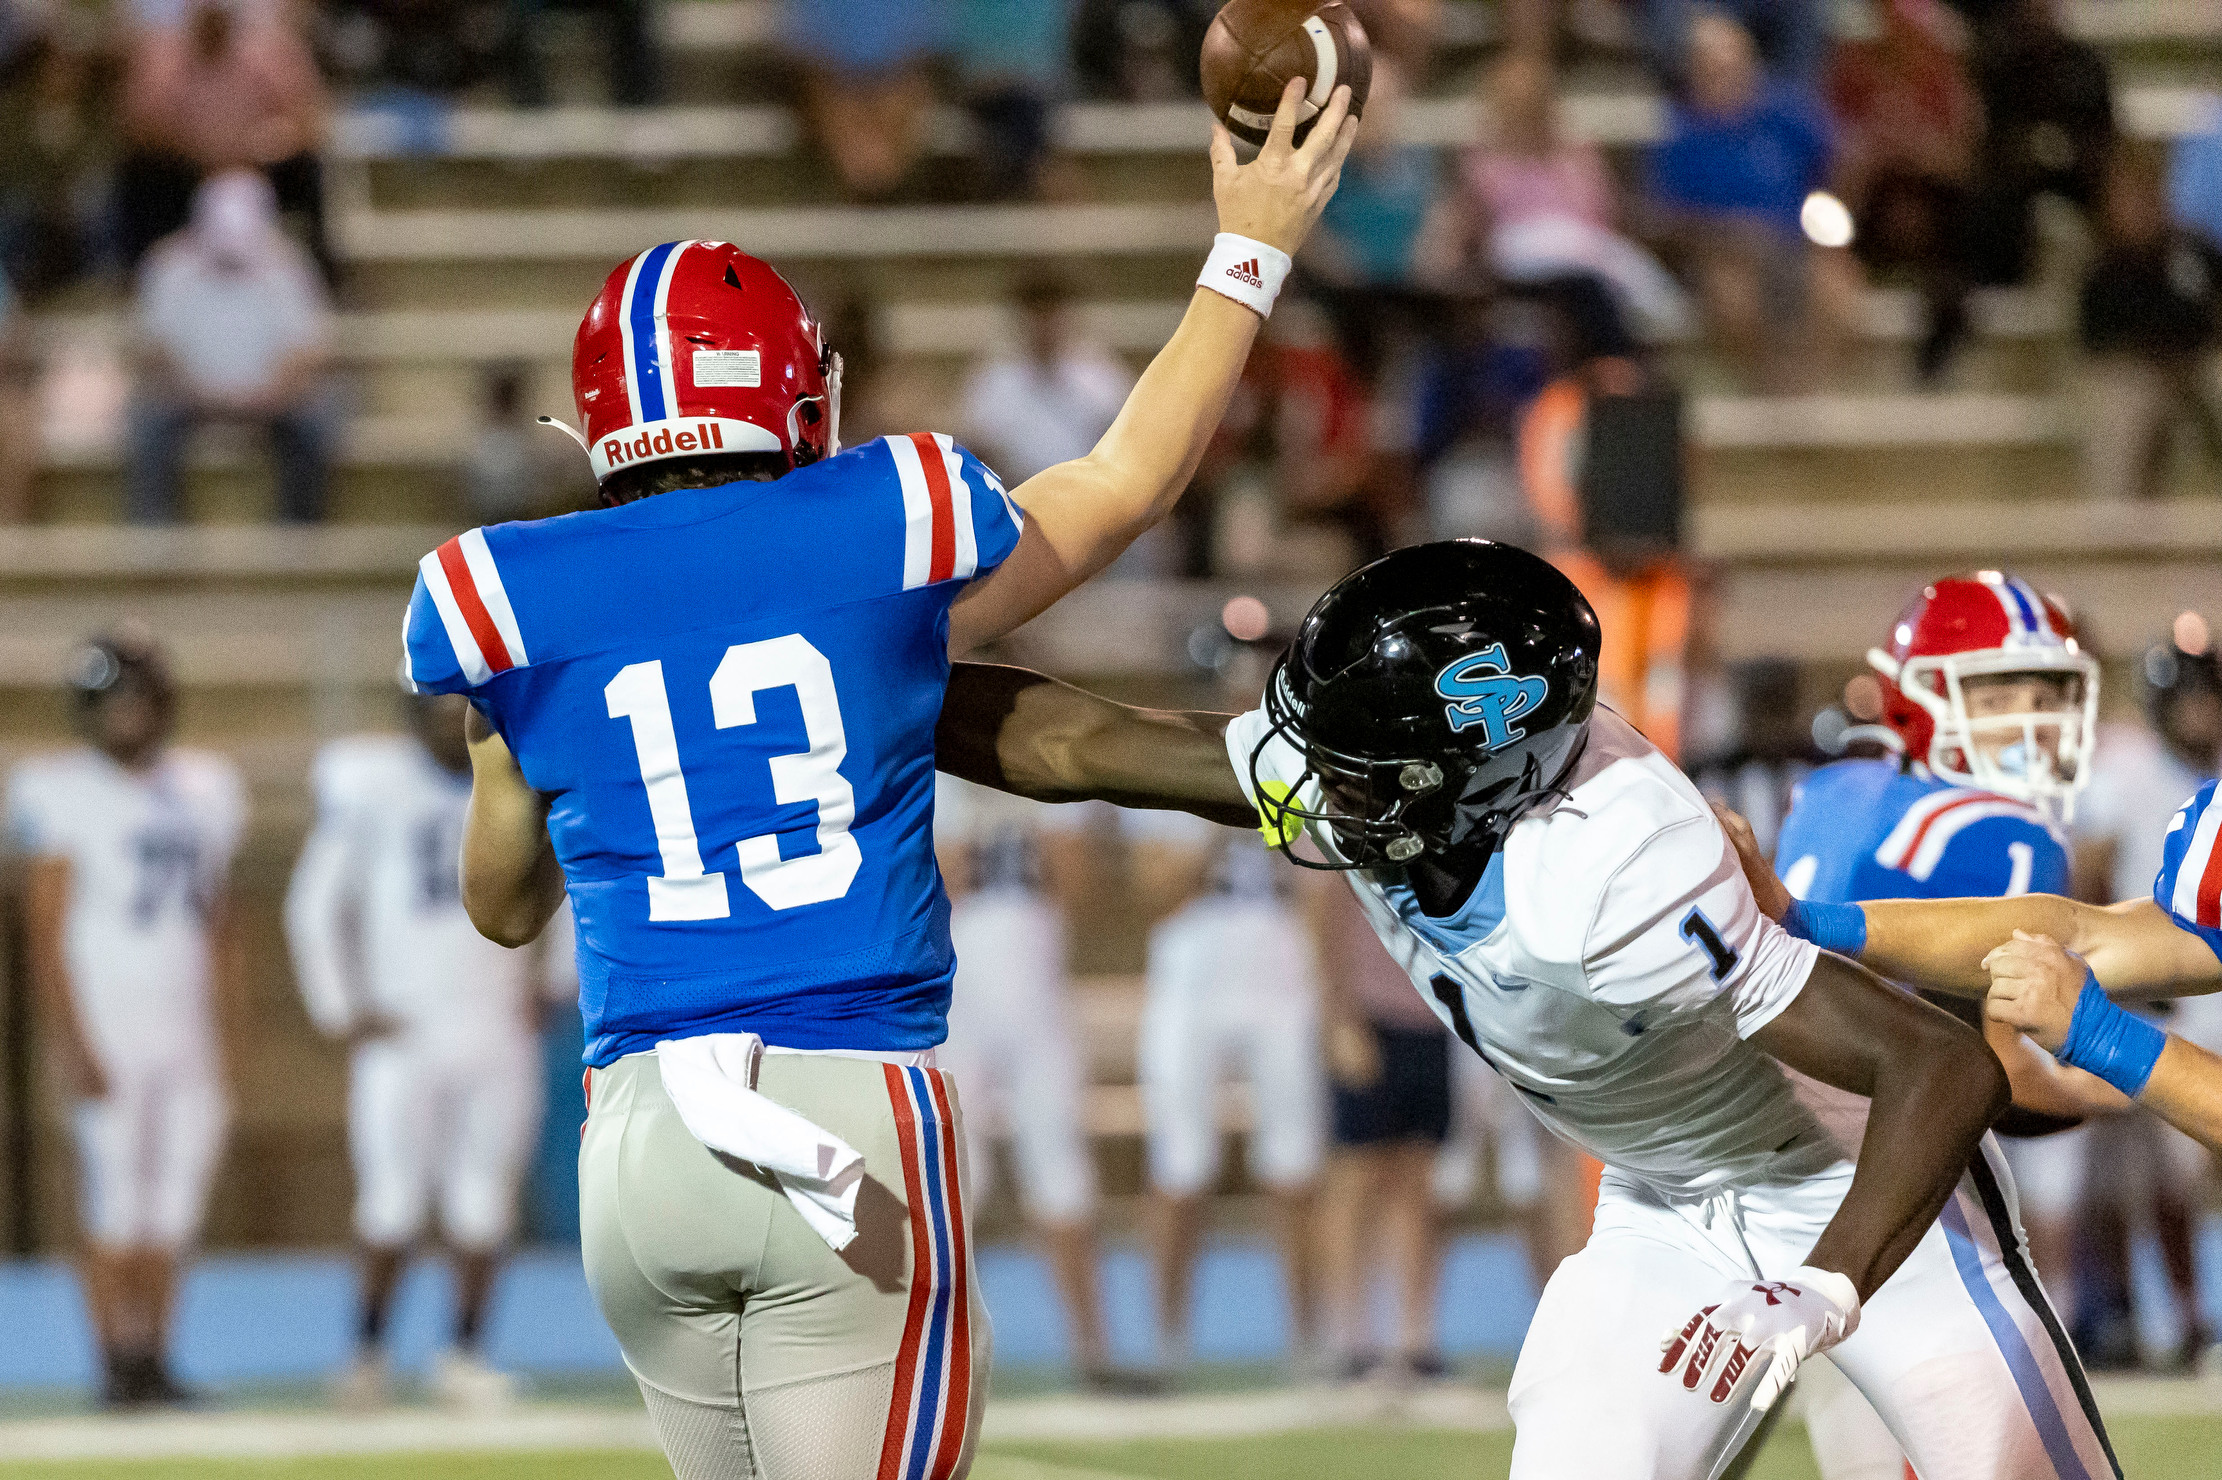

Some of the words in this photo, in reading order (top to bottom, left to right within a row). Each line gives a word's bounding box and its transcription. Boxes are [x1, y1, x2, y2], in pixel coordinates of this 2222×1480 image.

[1226, 268, 1262, 289] adidas
[603, 422, 724, 468] Riddell
[1280, 668, 1306, 718] Riddell
[604, 632, 863, 922] 13
[1679, 904, 1743, 987] 1
